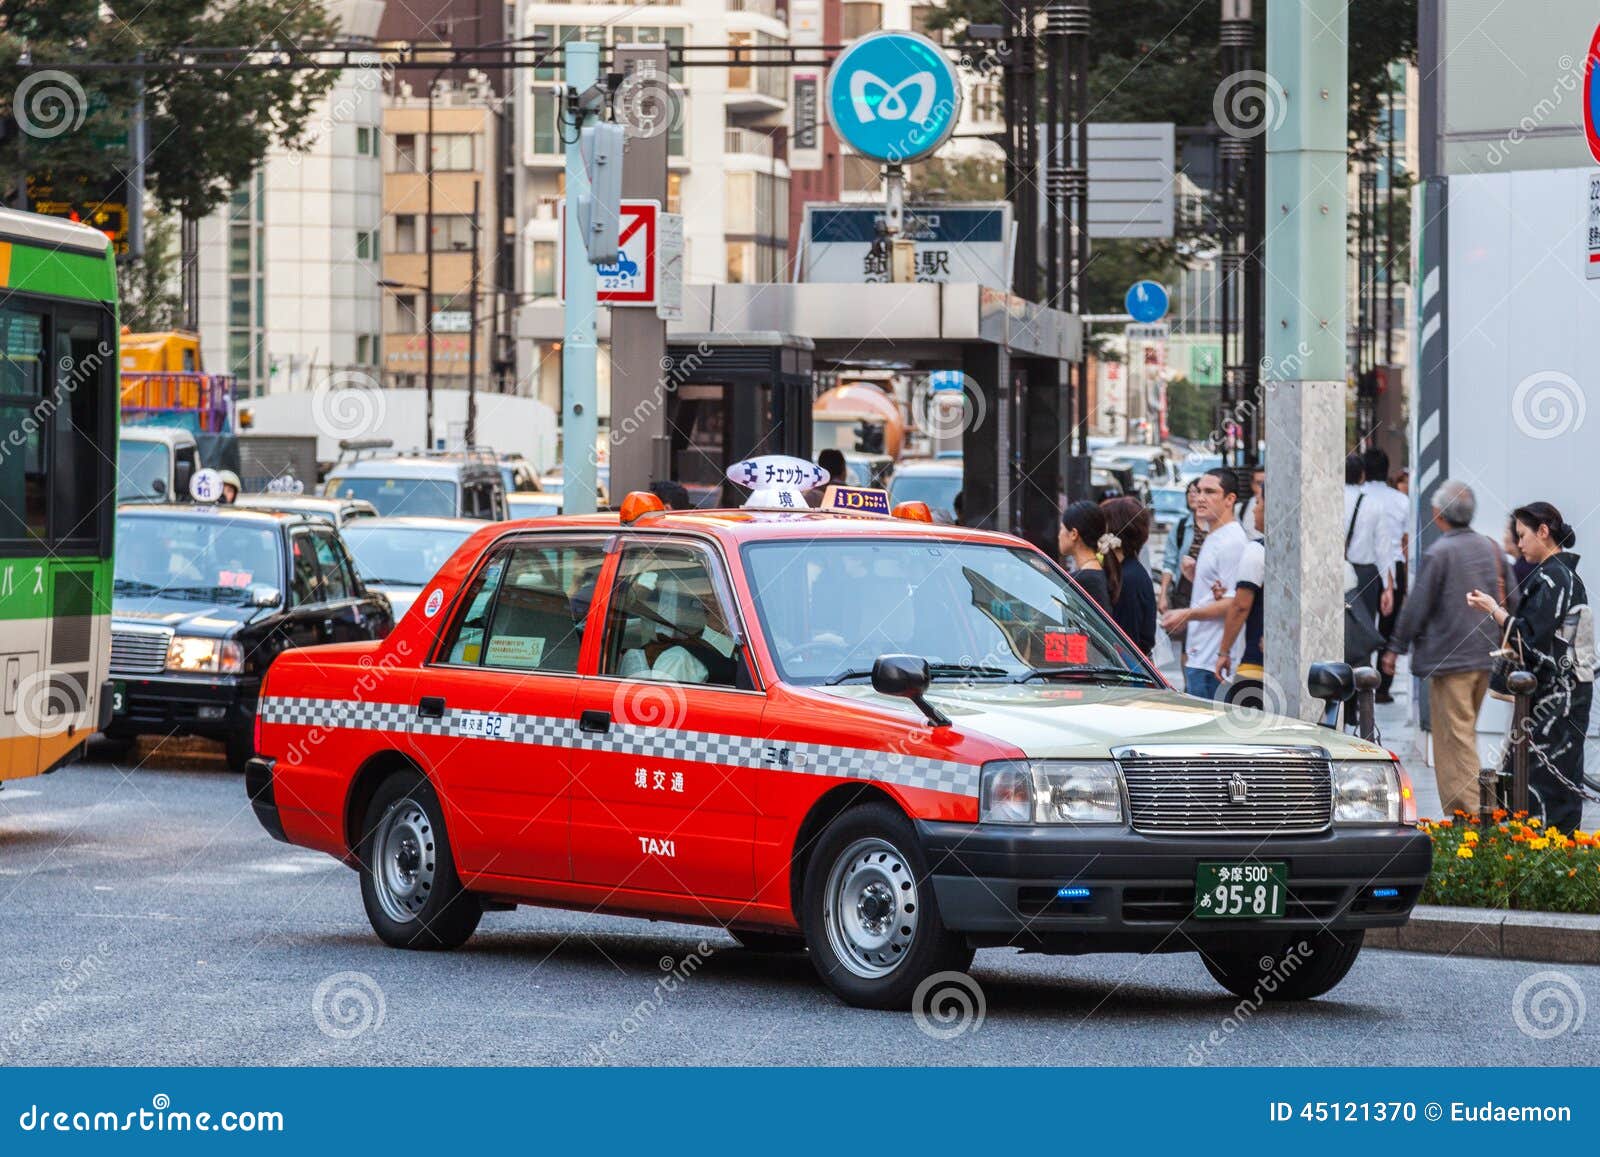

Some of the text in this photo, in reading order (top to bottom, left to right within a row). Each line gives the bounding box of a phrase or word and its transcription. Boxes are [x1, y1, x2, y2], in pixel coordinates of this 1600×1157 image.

[863, 250, 951, 276] 銀駅
[604, 279, 635, 288] 22-1
[765, 464, 810, 484] チェッカー
[778, 491, 794, 508] 境
[837, 491, 864, 508] iD
[2, 566, 43, 595] バス
[485, 716, 502, 736] 52
[635, 767, 684, 792] 境交通
[638, 836, 675, 857] TAXI
[1218, 866, 1268, 882] 多摩 500
[1200, 884, 1279, 915] あ 95-81
